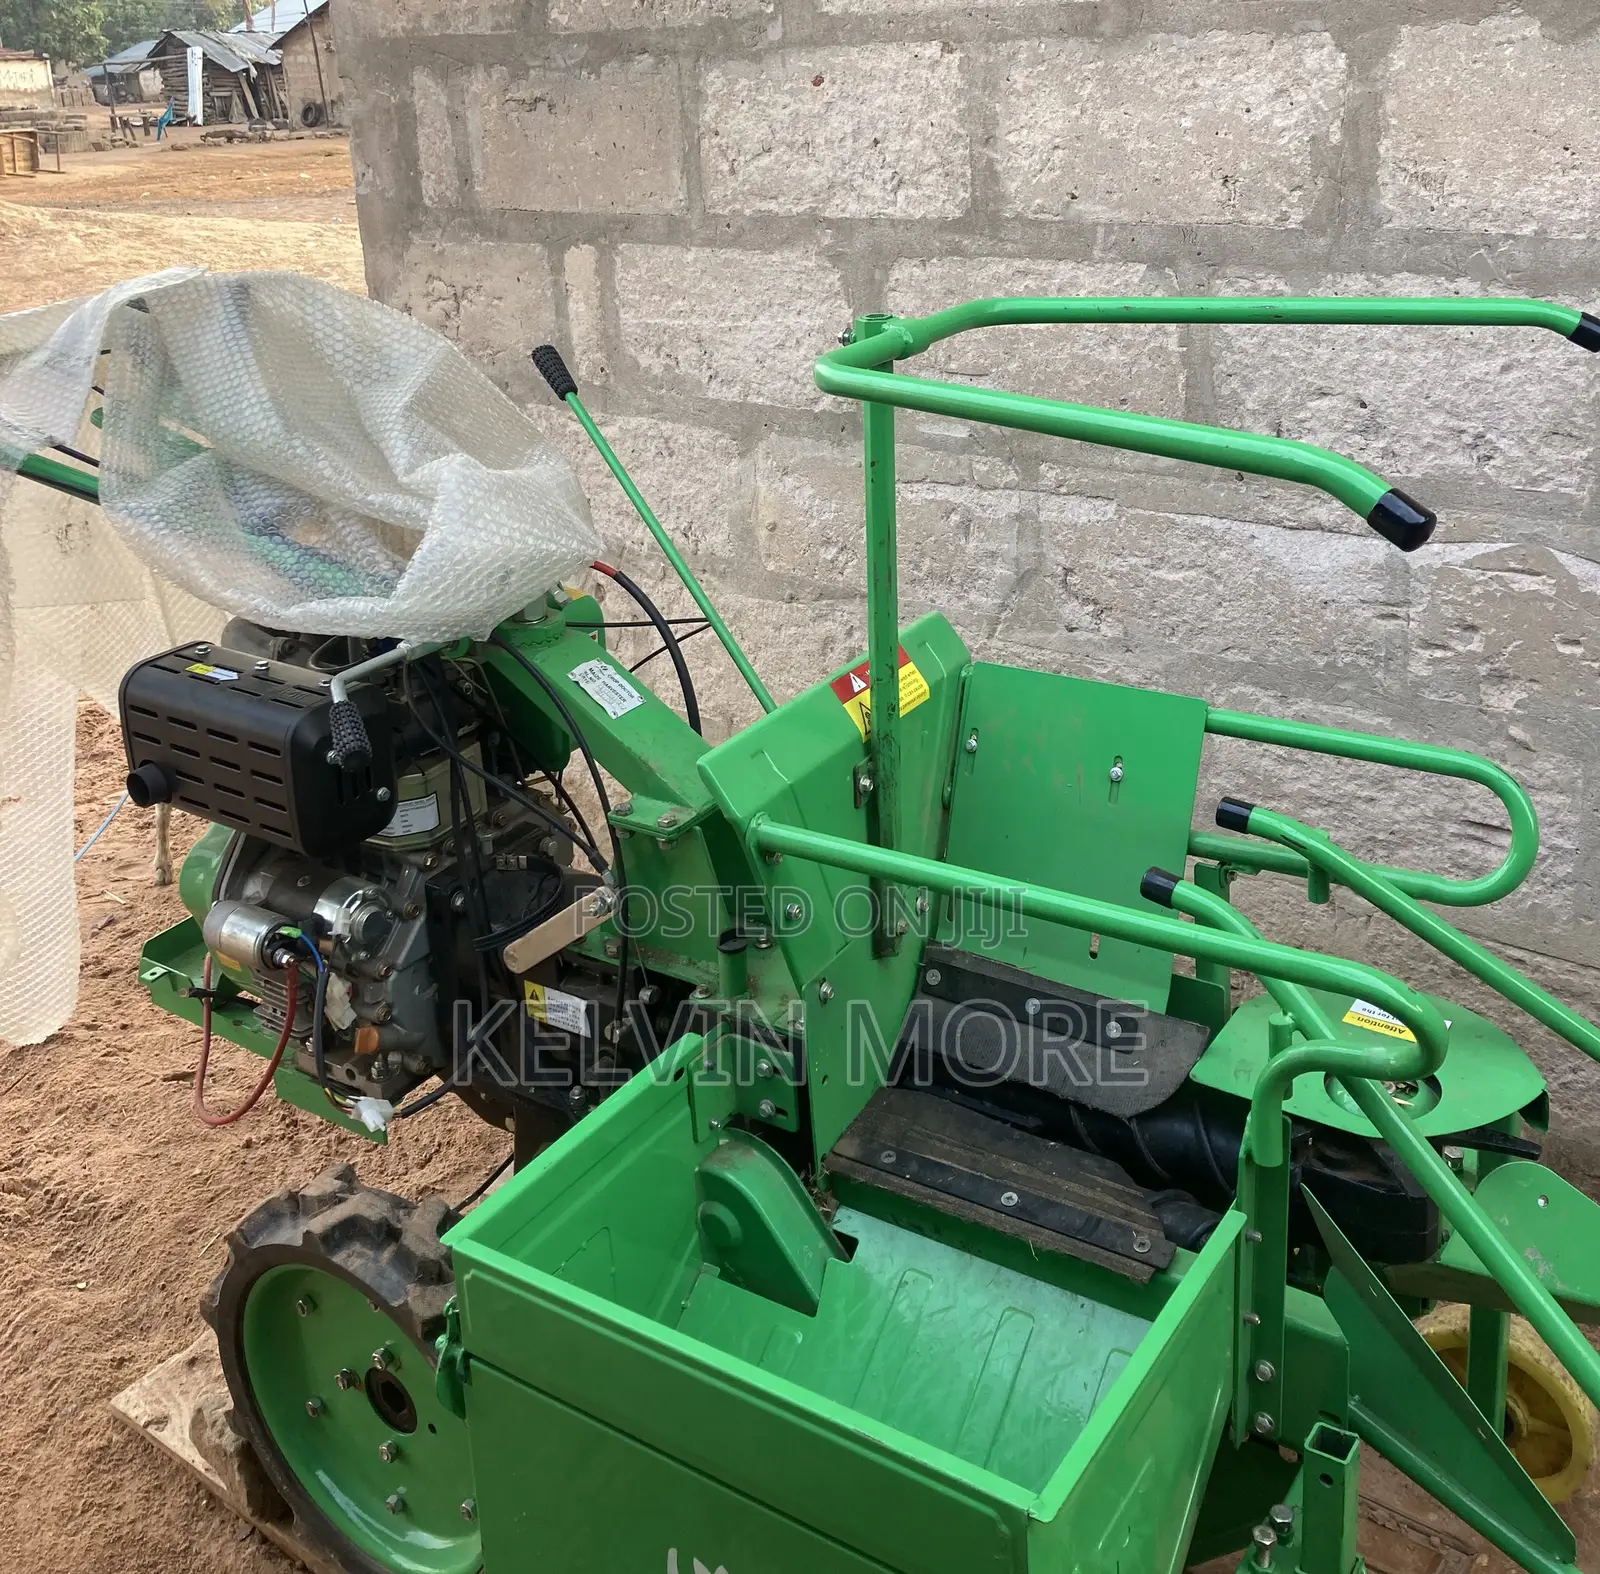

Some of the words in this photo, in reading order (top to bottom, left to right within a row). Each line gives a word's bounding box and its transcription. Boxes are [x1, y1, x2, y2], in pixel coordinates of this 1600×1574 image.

[588, 667, 602, 680] MAIZE
[601, 680, 627, 703] HARVESTER
[607, 674, 620, 684] CROP
[618, 682, 635, 699] DOCTOR
[1361, 1007, 1376, 1015] the
[1357, 1016, 1406, 1034] Attention
